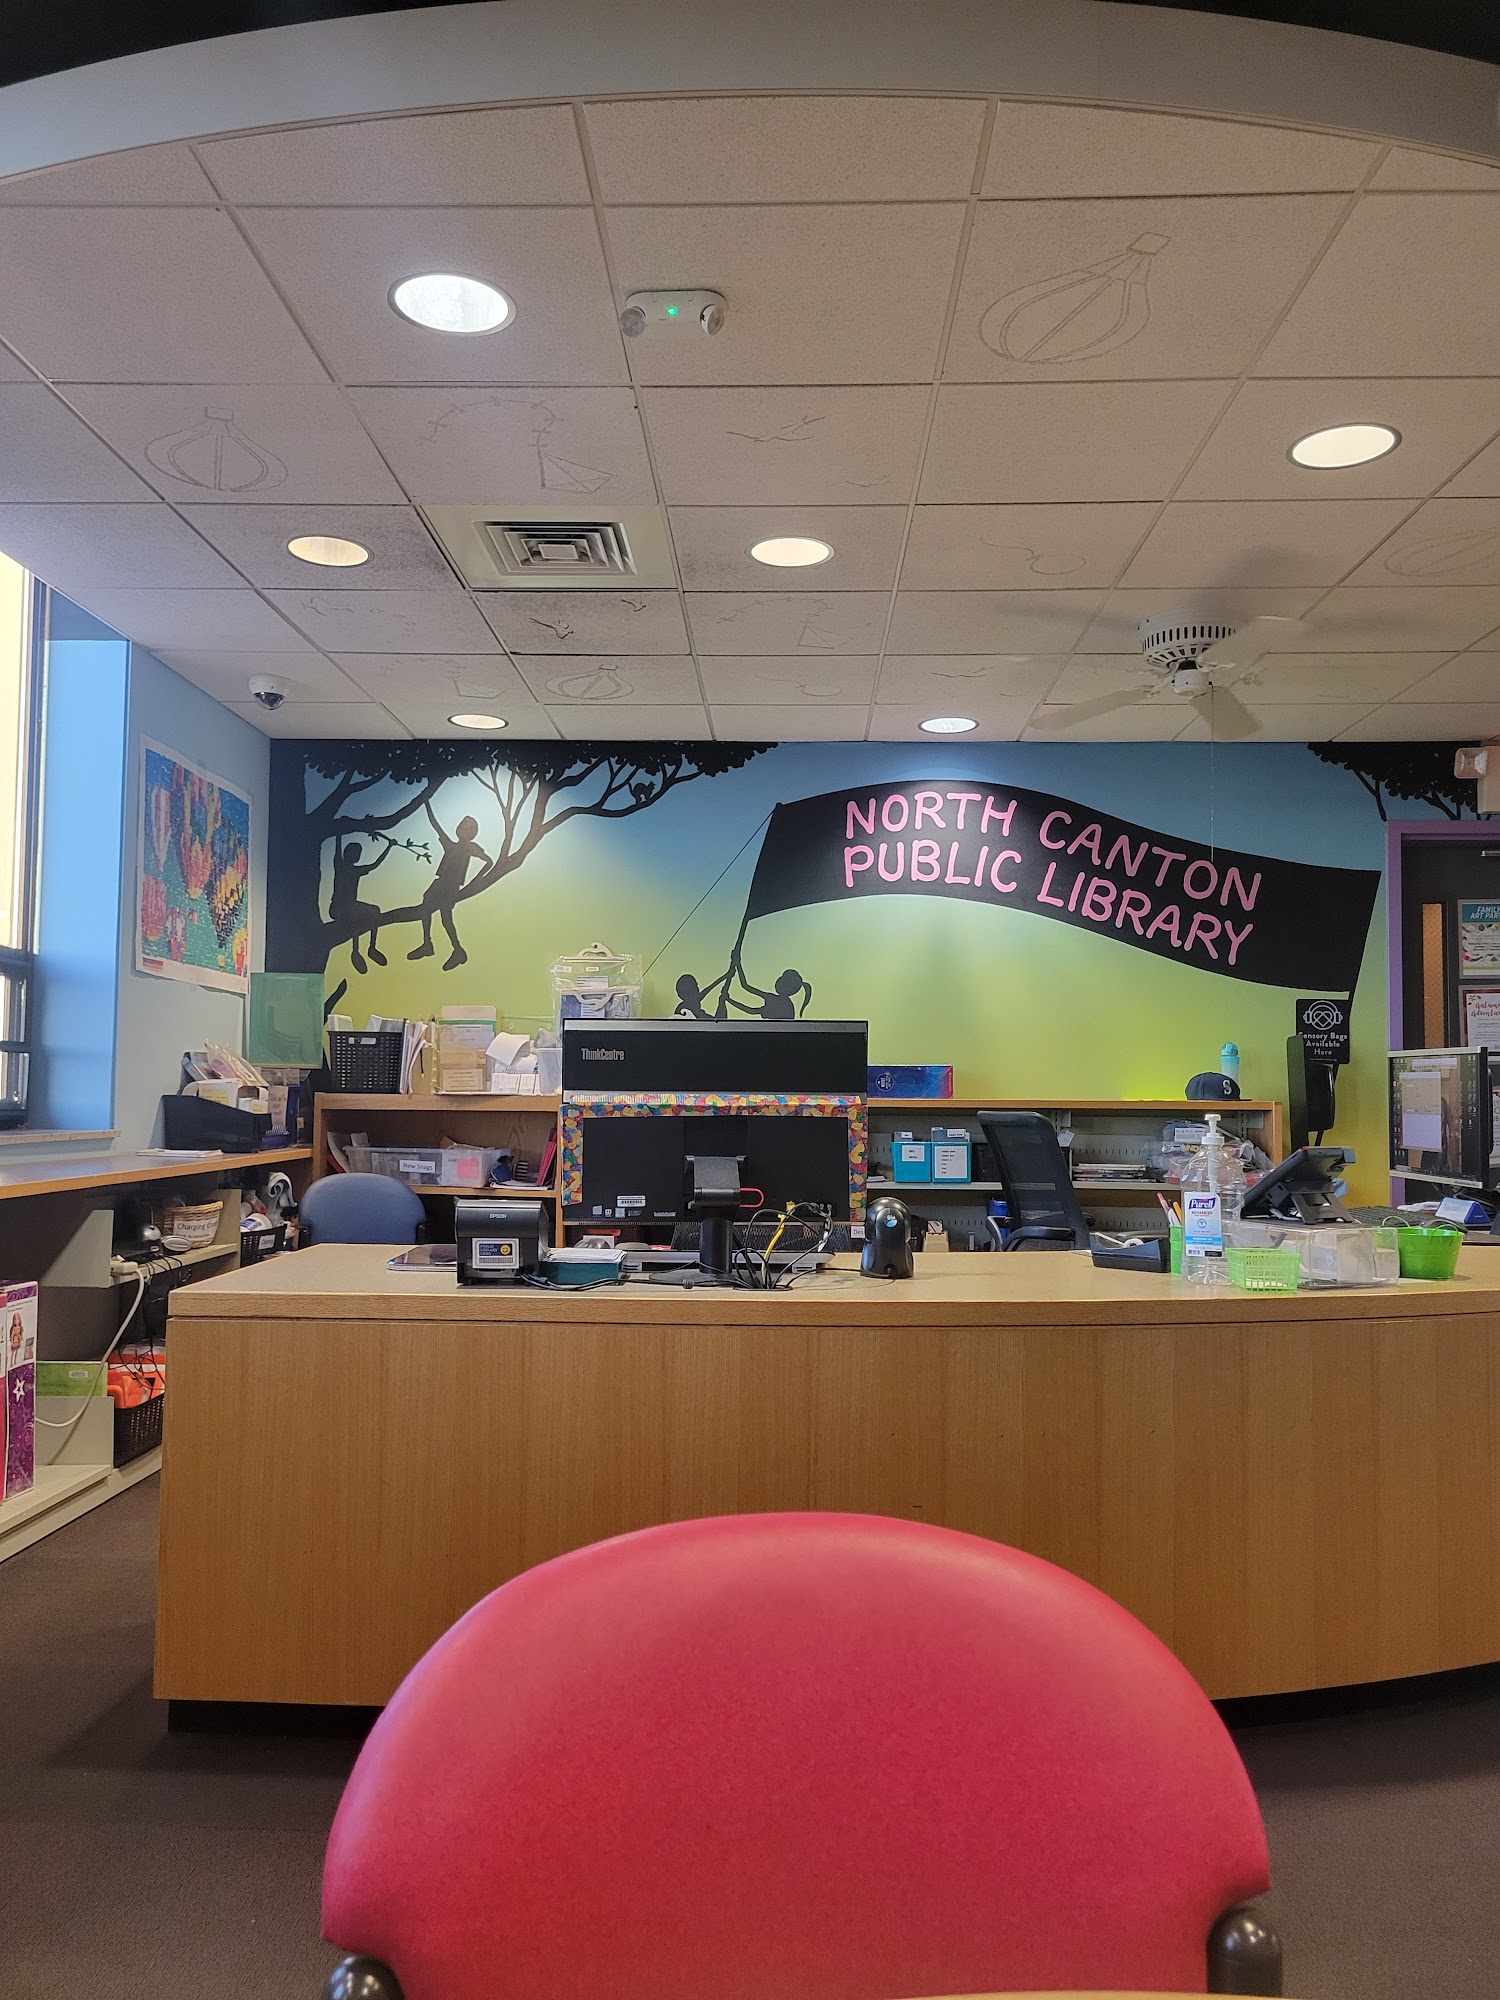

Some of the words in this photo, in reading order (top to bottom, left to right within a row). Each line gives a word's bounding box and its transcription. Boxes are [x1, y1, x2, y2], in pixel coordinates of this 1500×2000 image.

[845, 791, 1018, 839] NORTH
[1039, 810, 1262, 912] CANTON
[843, 840, 1022, 893] PUBLIC
[1036, 861, 1254, 966] LIBRARY
[1330, 1031, 1348, 1042] Bags
[1305, 1040, 1341, 1048] Available
[581, 1048, 625, 1061] ThinkCentre
[1314, 1048, 1333, 1056] Here
[417, 1163, 433, 1171] Snags
[177, 1222, 206, 1232] Charging
